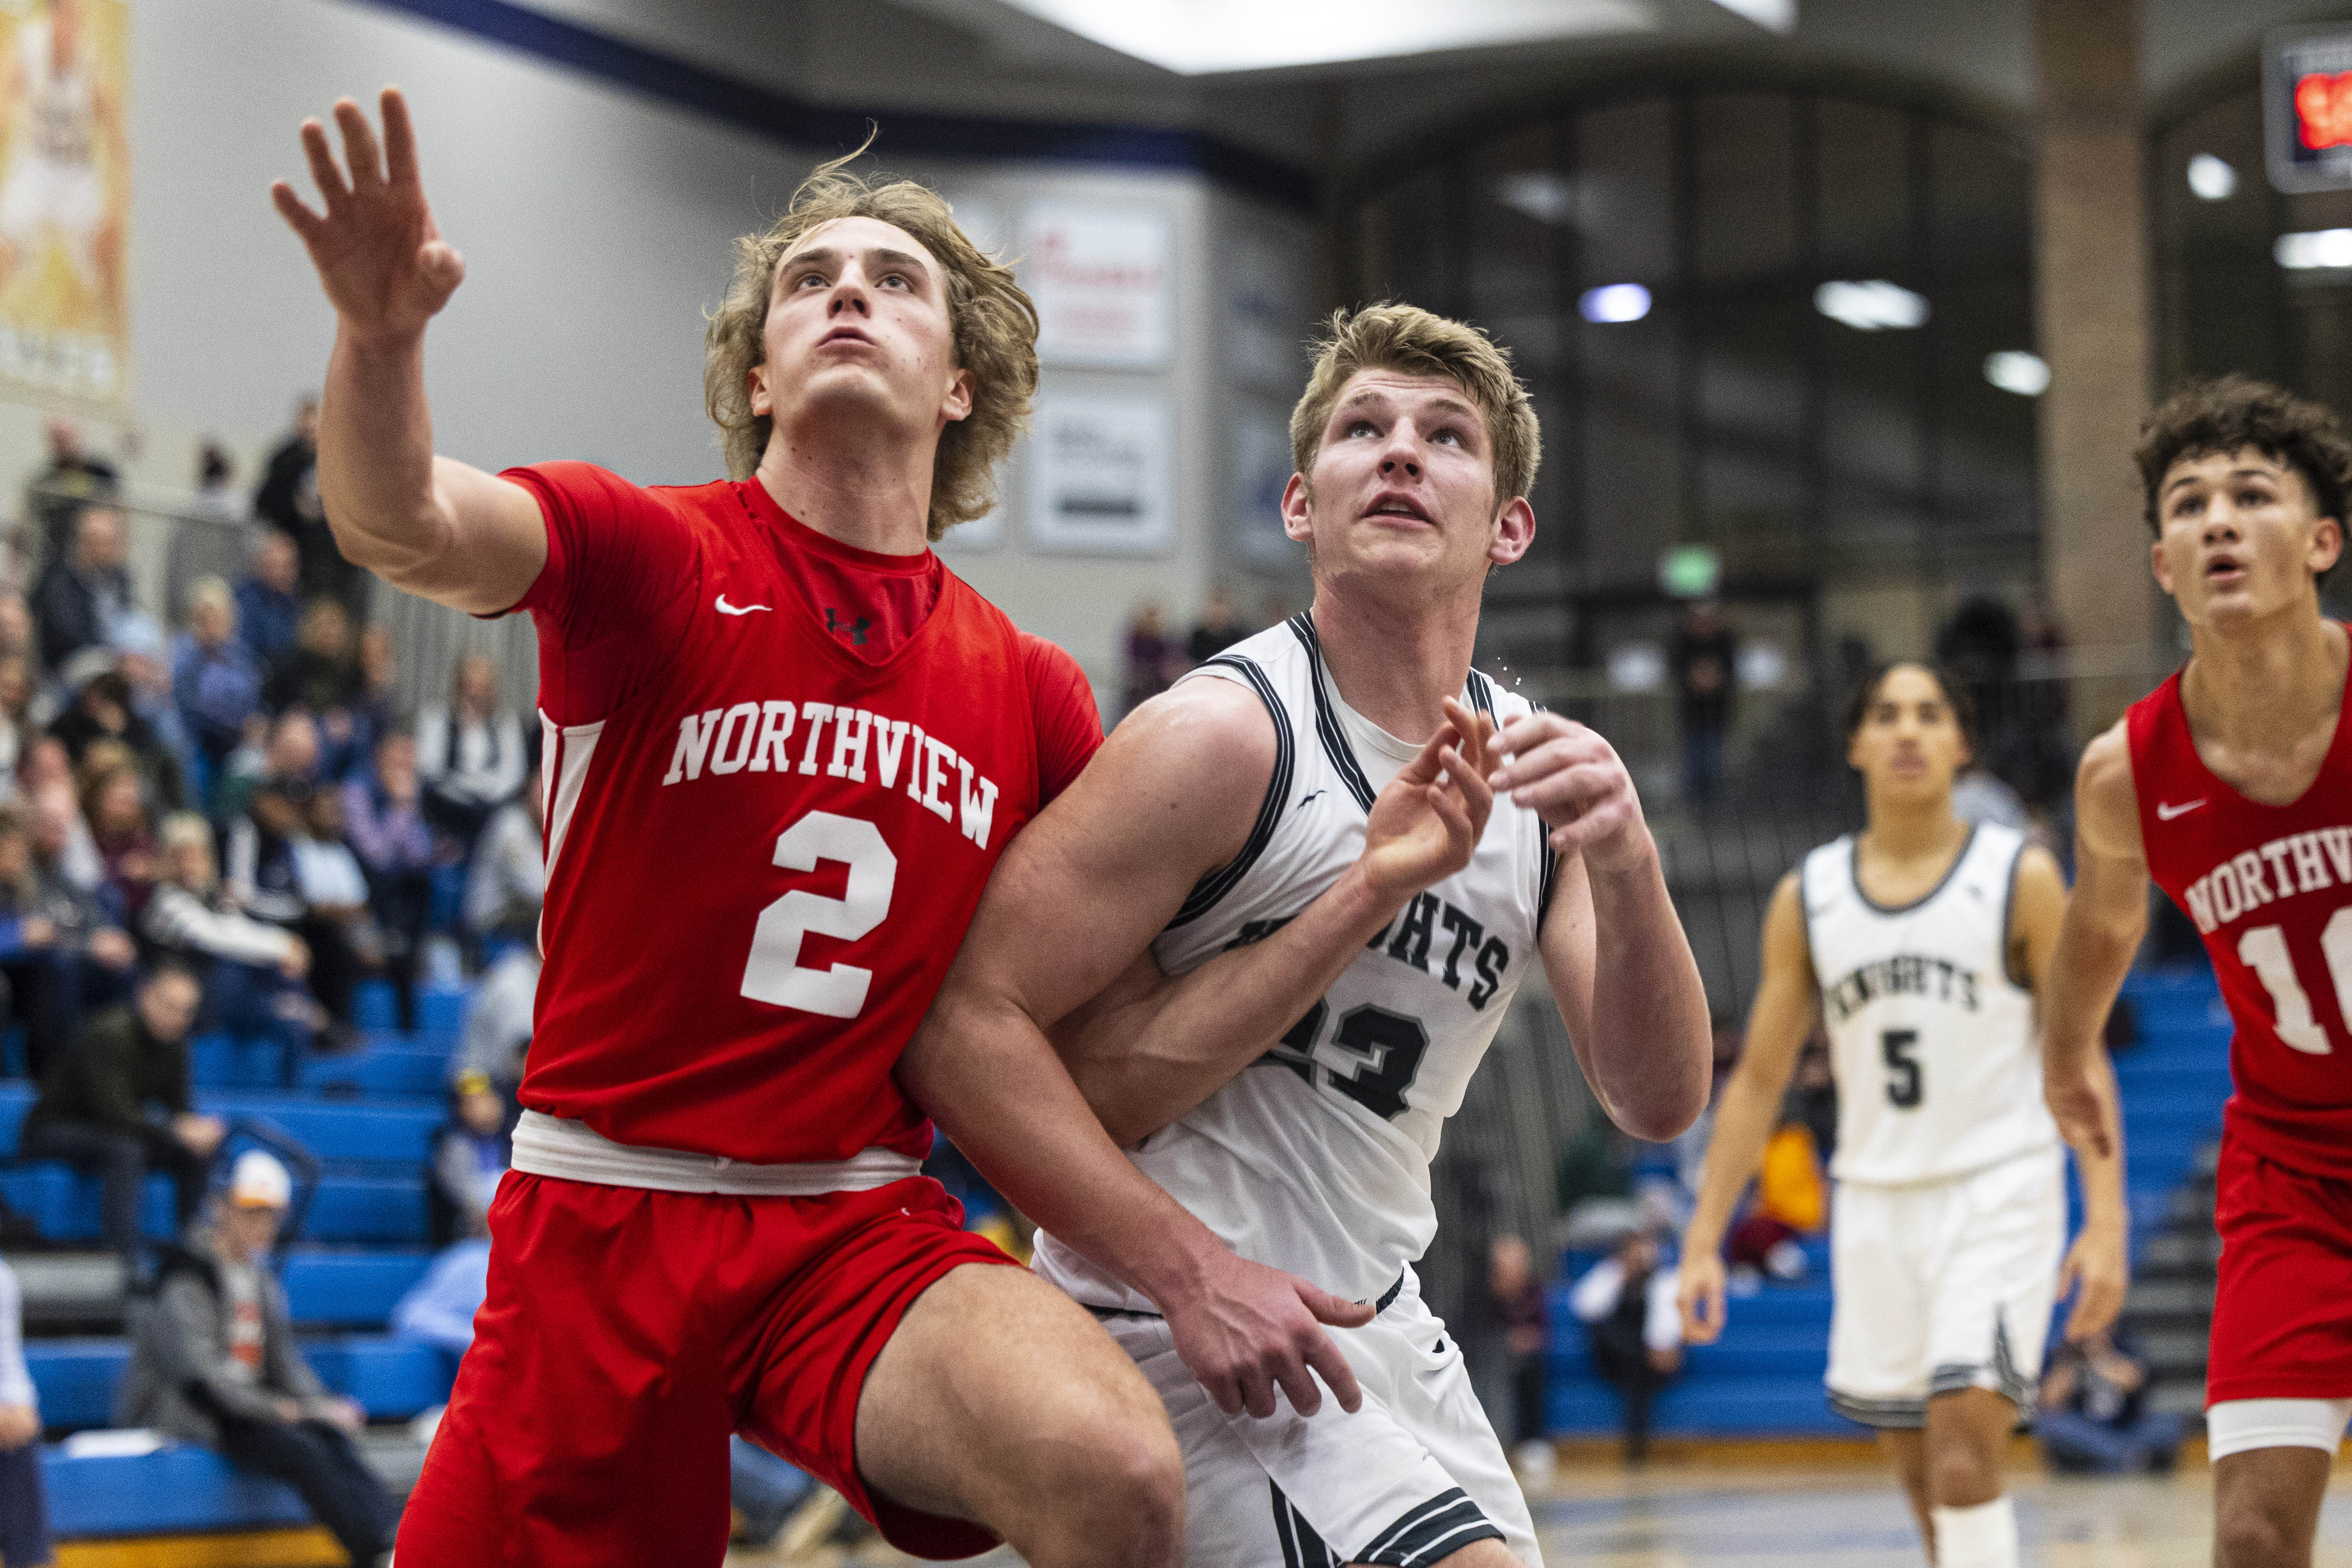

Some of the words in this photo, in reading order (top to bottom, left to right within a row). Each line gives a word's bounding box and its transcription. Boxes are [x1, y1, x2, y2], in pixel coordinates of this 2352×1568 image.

[662, 700, 999, 851] NORTHVIEW
[740, 809, 898, 1019] 2
[1881, 1027, 1924, 1109] 5
